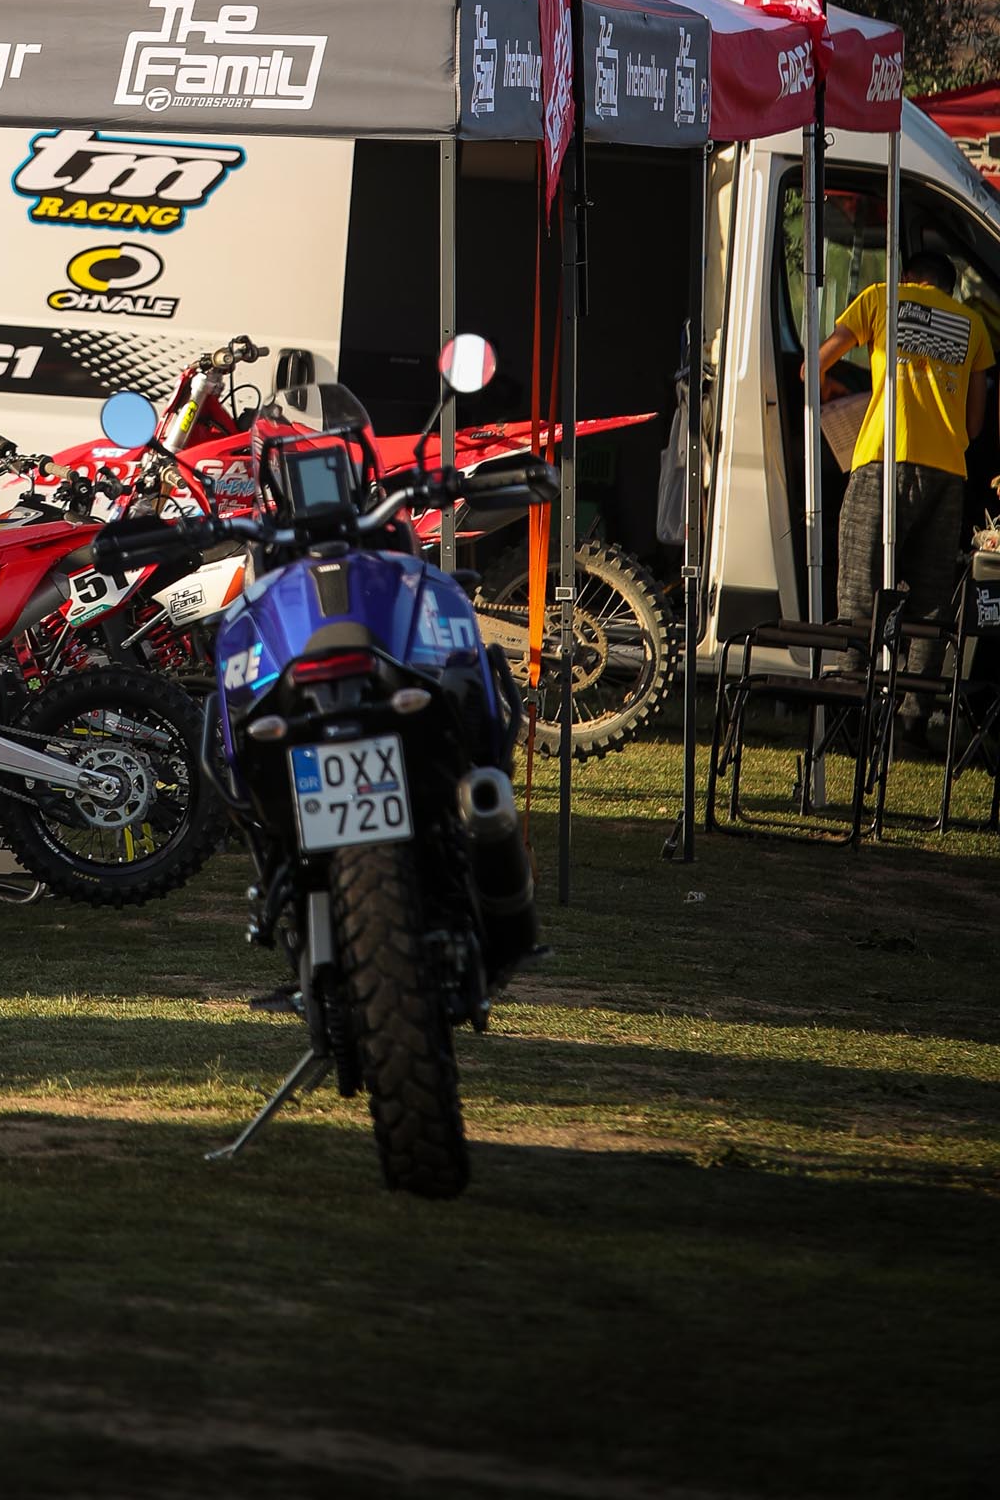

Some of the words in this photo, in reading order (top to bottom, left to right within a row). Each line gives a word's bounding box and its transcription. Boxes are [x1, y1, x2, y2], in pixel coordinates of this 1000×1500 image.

[132, 35, 329, 110] Family
[171, 96, 252, 109] MOTORSPORT
[31, 195, 180, 227] RACING
[49, 290, 177, 317] OHVALE
[324, 746, 398, 788] OXX
[329, 796, 404, 836] 720
